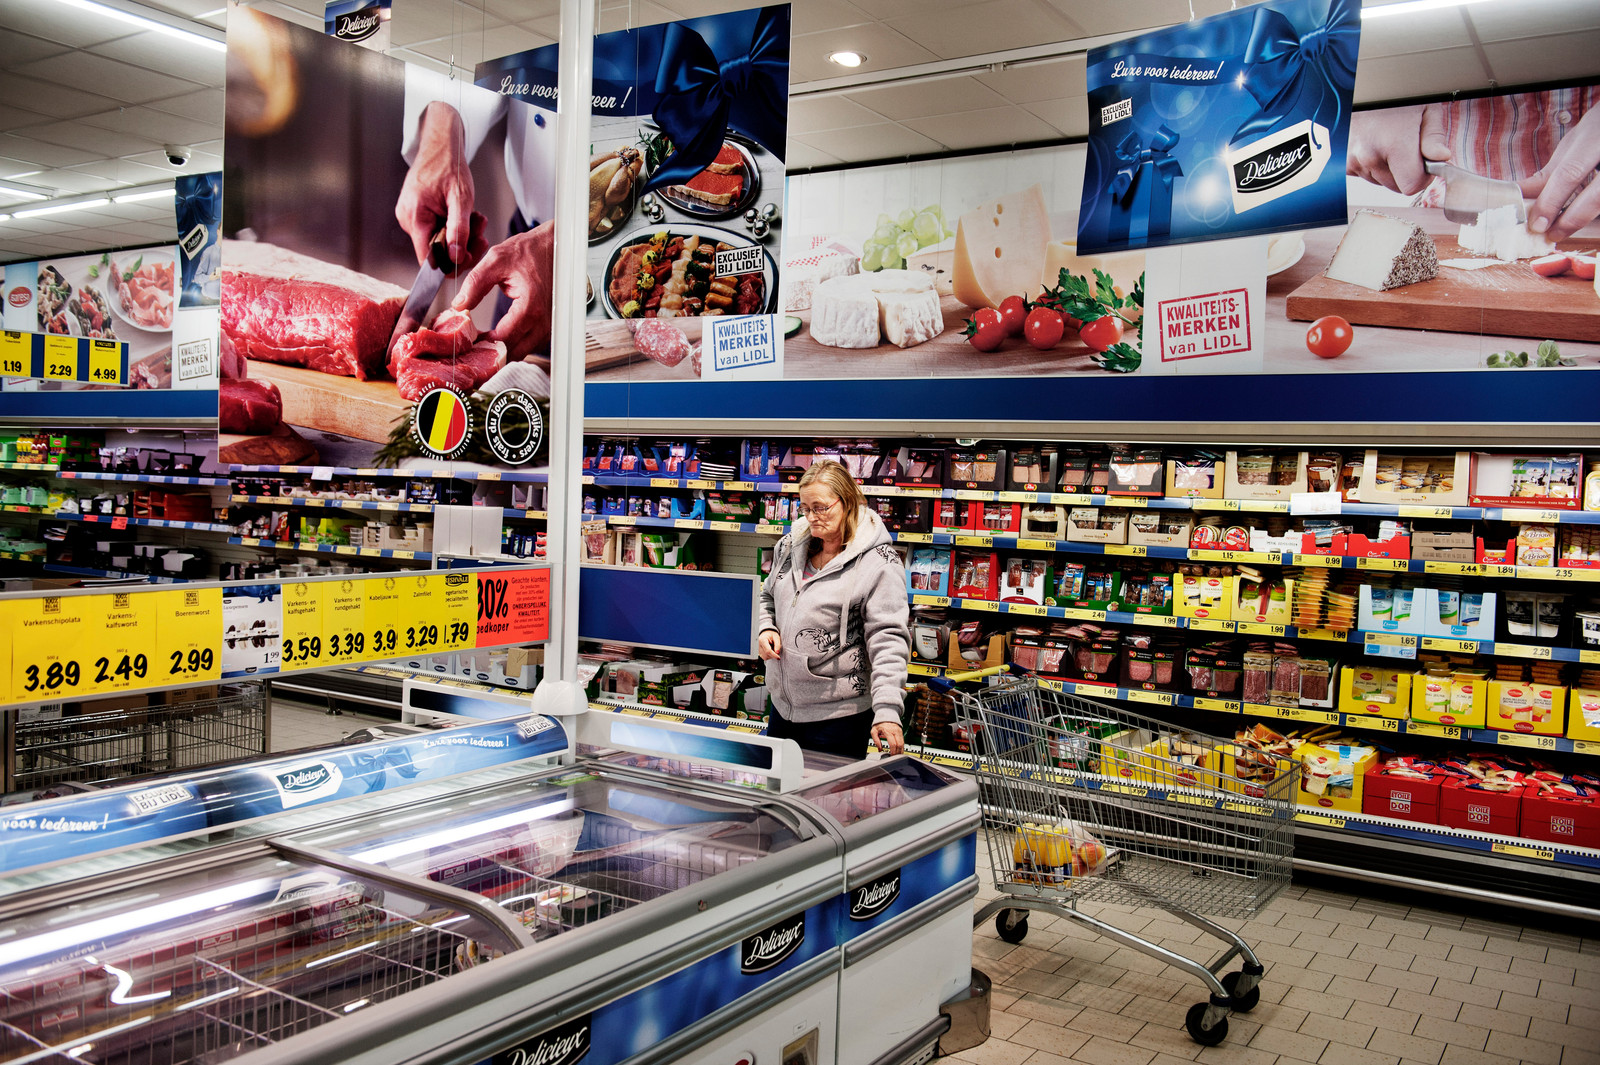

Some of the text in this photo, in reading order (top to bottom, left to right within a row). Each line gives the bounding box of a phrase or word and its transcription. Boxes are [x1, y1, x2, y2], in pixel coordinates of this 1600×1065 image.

[338, 14, 379, 36] Delicieux
[1111, 61, 1225, 80] Luxe voor iedereen!
[497, 75, 558, 100] Luxe voor
[1103, 101, 1130, 117] EXCLUSIEF
[1104, 108, 1131, 123] BIJ LIDL!
[1240, 144, 1307, 186] Delicieux
[718, 248, 760, 264] EXCLUSIEF
[718, 258, 762, 274] BIJ LIDL!
[1167, 297, 1240, 322] KWALITEITS-
[718, 319, 767, 338] KWALITEITS-
[1168, 314, 1240, 338] MERKEN
[720, 333, 768, 352] MERKEN
[1169, 334, 1242, 355] van LIDL
[182, 354, 208, 366] MERKEN
[720, 348, 769, 366] van LIDL
[4, 360, 22, 372] 1.19
[50, 364, 72, 376] 2.29
[94, 368, 116, 380] 4.99
[194, 364, 209, 374] LIDL
[488, 395, 509, 459] frais du jour
[517, 394, 542, 458] dagelijks vers
[1392, 560, 1406, 568] 1.79
[24, 616, 81, 627] Varkenschipolata
[106, 621, 138, 629] kalfsworst
[329, 632, 364, 657] 3.39
[406, 625, 438, 648] 3.29
[282, 636, 321, 662] 3.59
[1459, 642, 1474, 650] 1.65
[1533, 648, 1550, 656] 2.29
[169, 648, 213, 675] 2.99
[264, 652, 279, 663] 1.99
[24, 660, 80, 692] 3.89
[94, 653, 147, 683] 2.49
[526, 726, 536, 735] BIJ
[1443, 727, 1459, 736] 1.85
[447, 737, 468, 747] voor
[470, 736, 504, 748] iedereen
[1537, 738, 1553, 746] 1.89
[284, 768, 326, 790] Delicieux
[134, 784, 180, 802] EXCLUSIEF
[140, 790, 188, 809] BIJ LIDL!
[1469, 805, 1489, 815] ETOILE
[1469, 813, 1489, 824] D'OR
[40, 816, 100, 832] iedereen
[1552, 824, 1574, 835] D'OR
[853, 877, 899, 913] Delicieux
[745, 922, 803, 966] Delicieux
